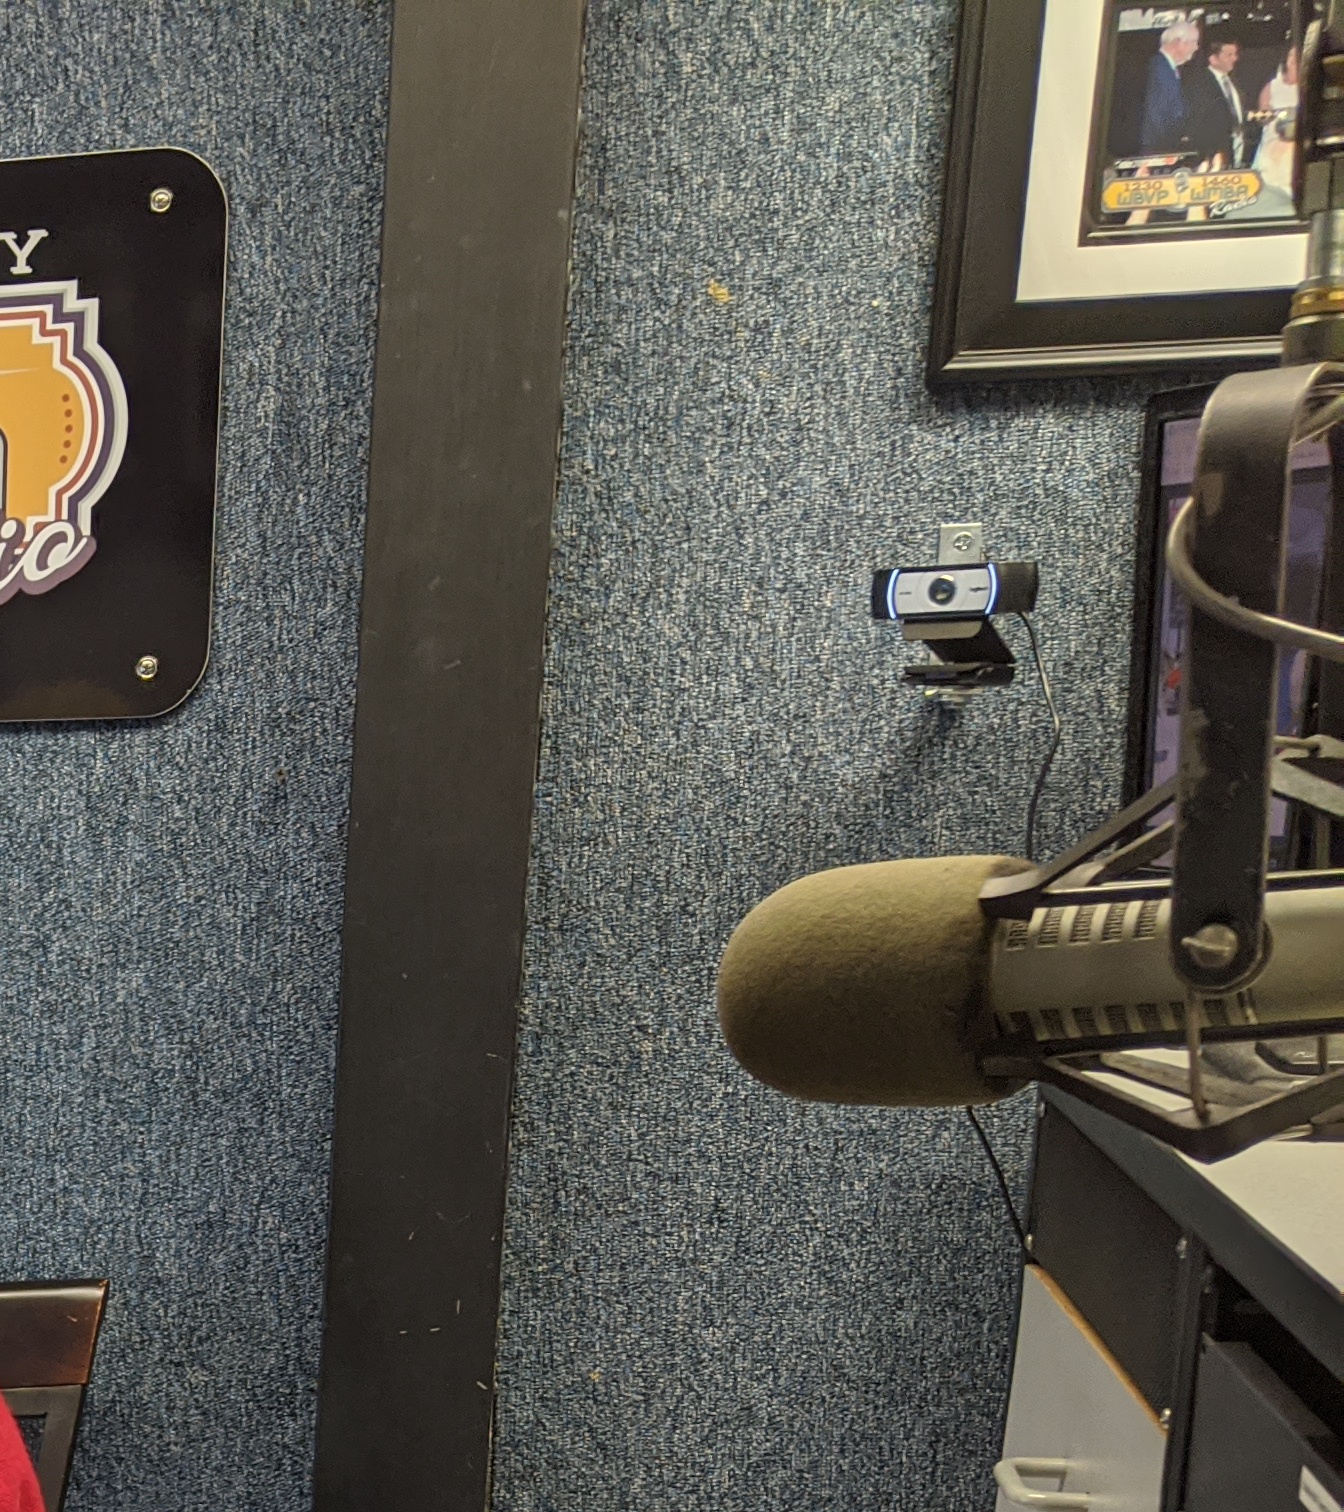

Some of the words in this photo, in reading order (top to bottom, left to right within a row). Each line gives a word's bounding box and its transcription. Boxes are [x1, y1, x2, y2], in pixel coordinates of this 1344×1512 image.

[1124, 180, 1163, 192] 1230
[1201, 175, 1242, 188] 1460
[1117, 190, 1170, 205] WBVP
